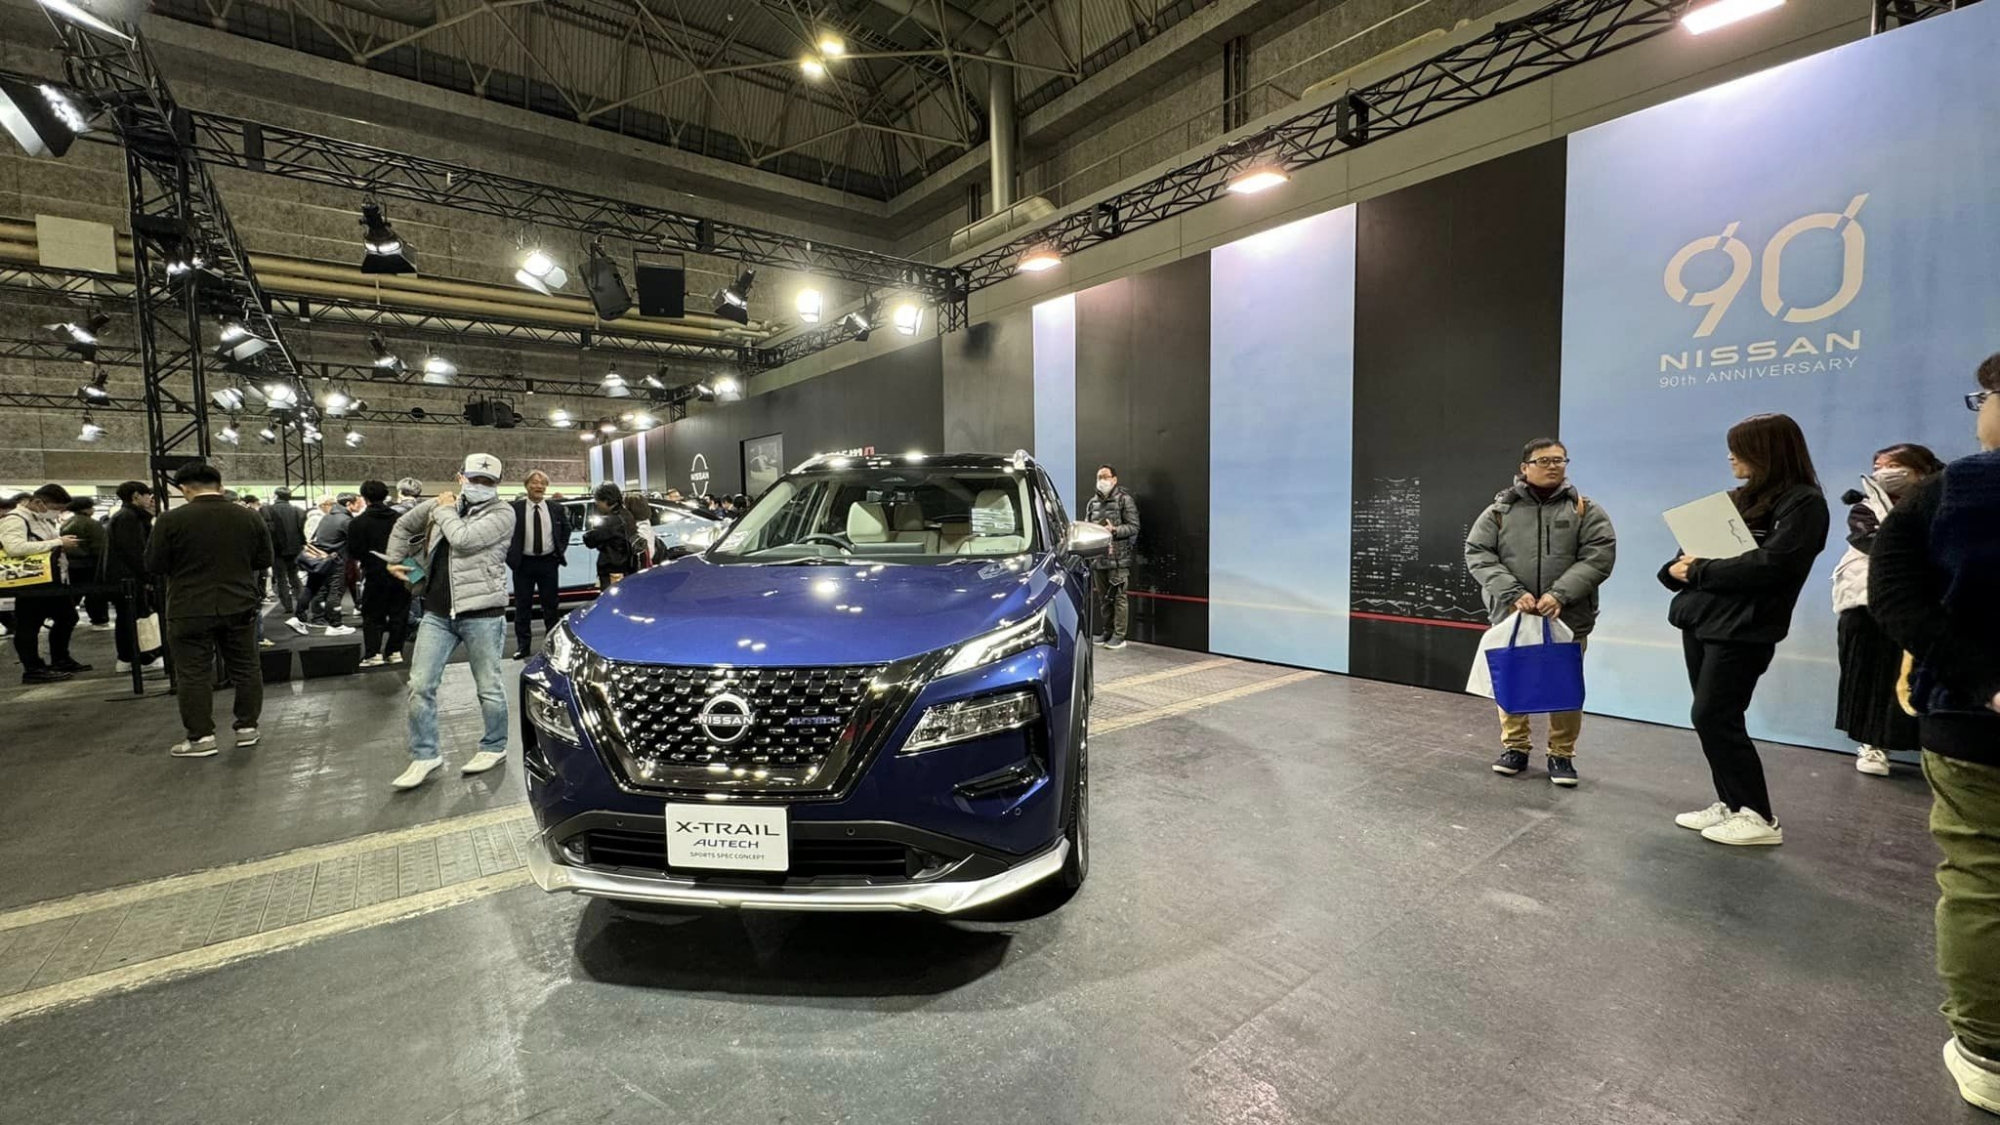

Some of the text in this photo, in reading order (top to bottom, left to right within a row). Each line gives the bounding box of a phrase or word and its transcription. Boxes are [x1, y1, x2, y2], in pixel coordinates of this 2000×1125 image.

[1663, 192, 1869, 338] 90
[1660, 329, 1861, 372] NISSAN
[1659, 356, 1858, 388] 90th ANNIVERSARY
[698, 712, 755, 725] NISSAN
[675, 821, 780, 836] X-TRAIL
[693, 838, 759, 849] AUTECH
[690, 851, 716, 859] SPORTS
